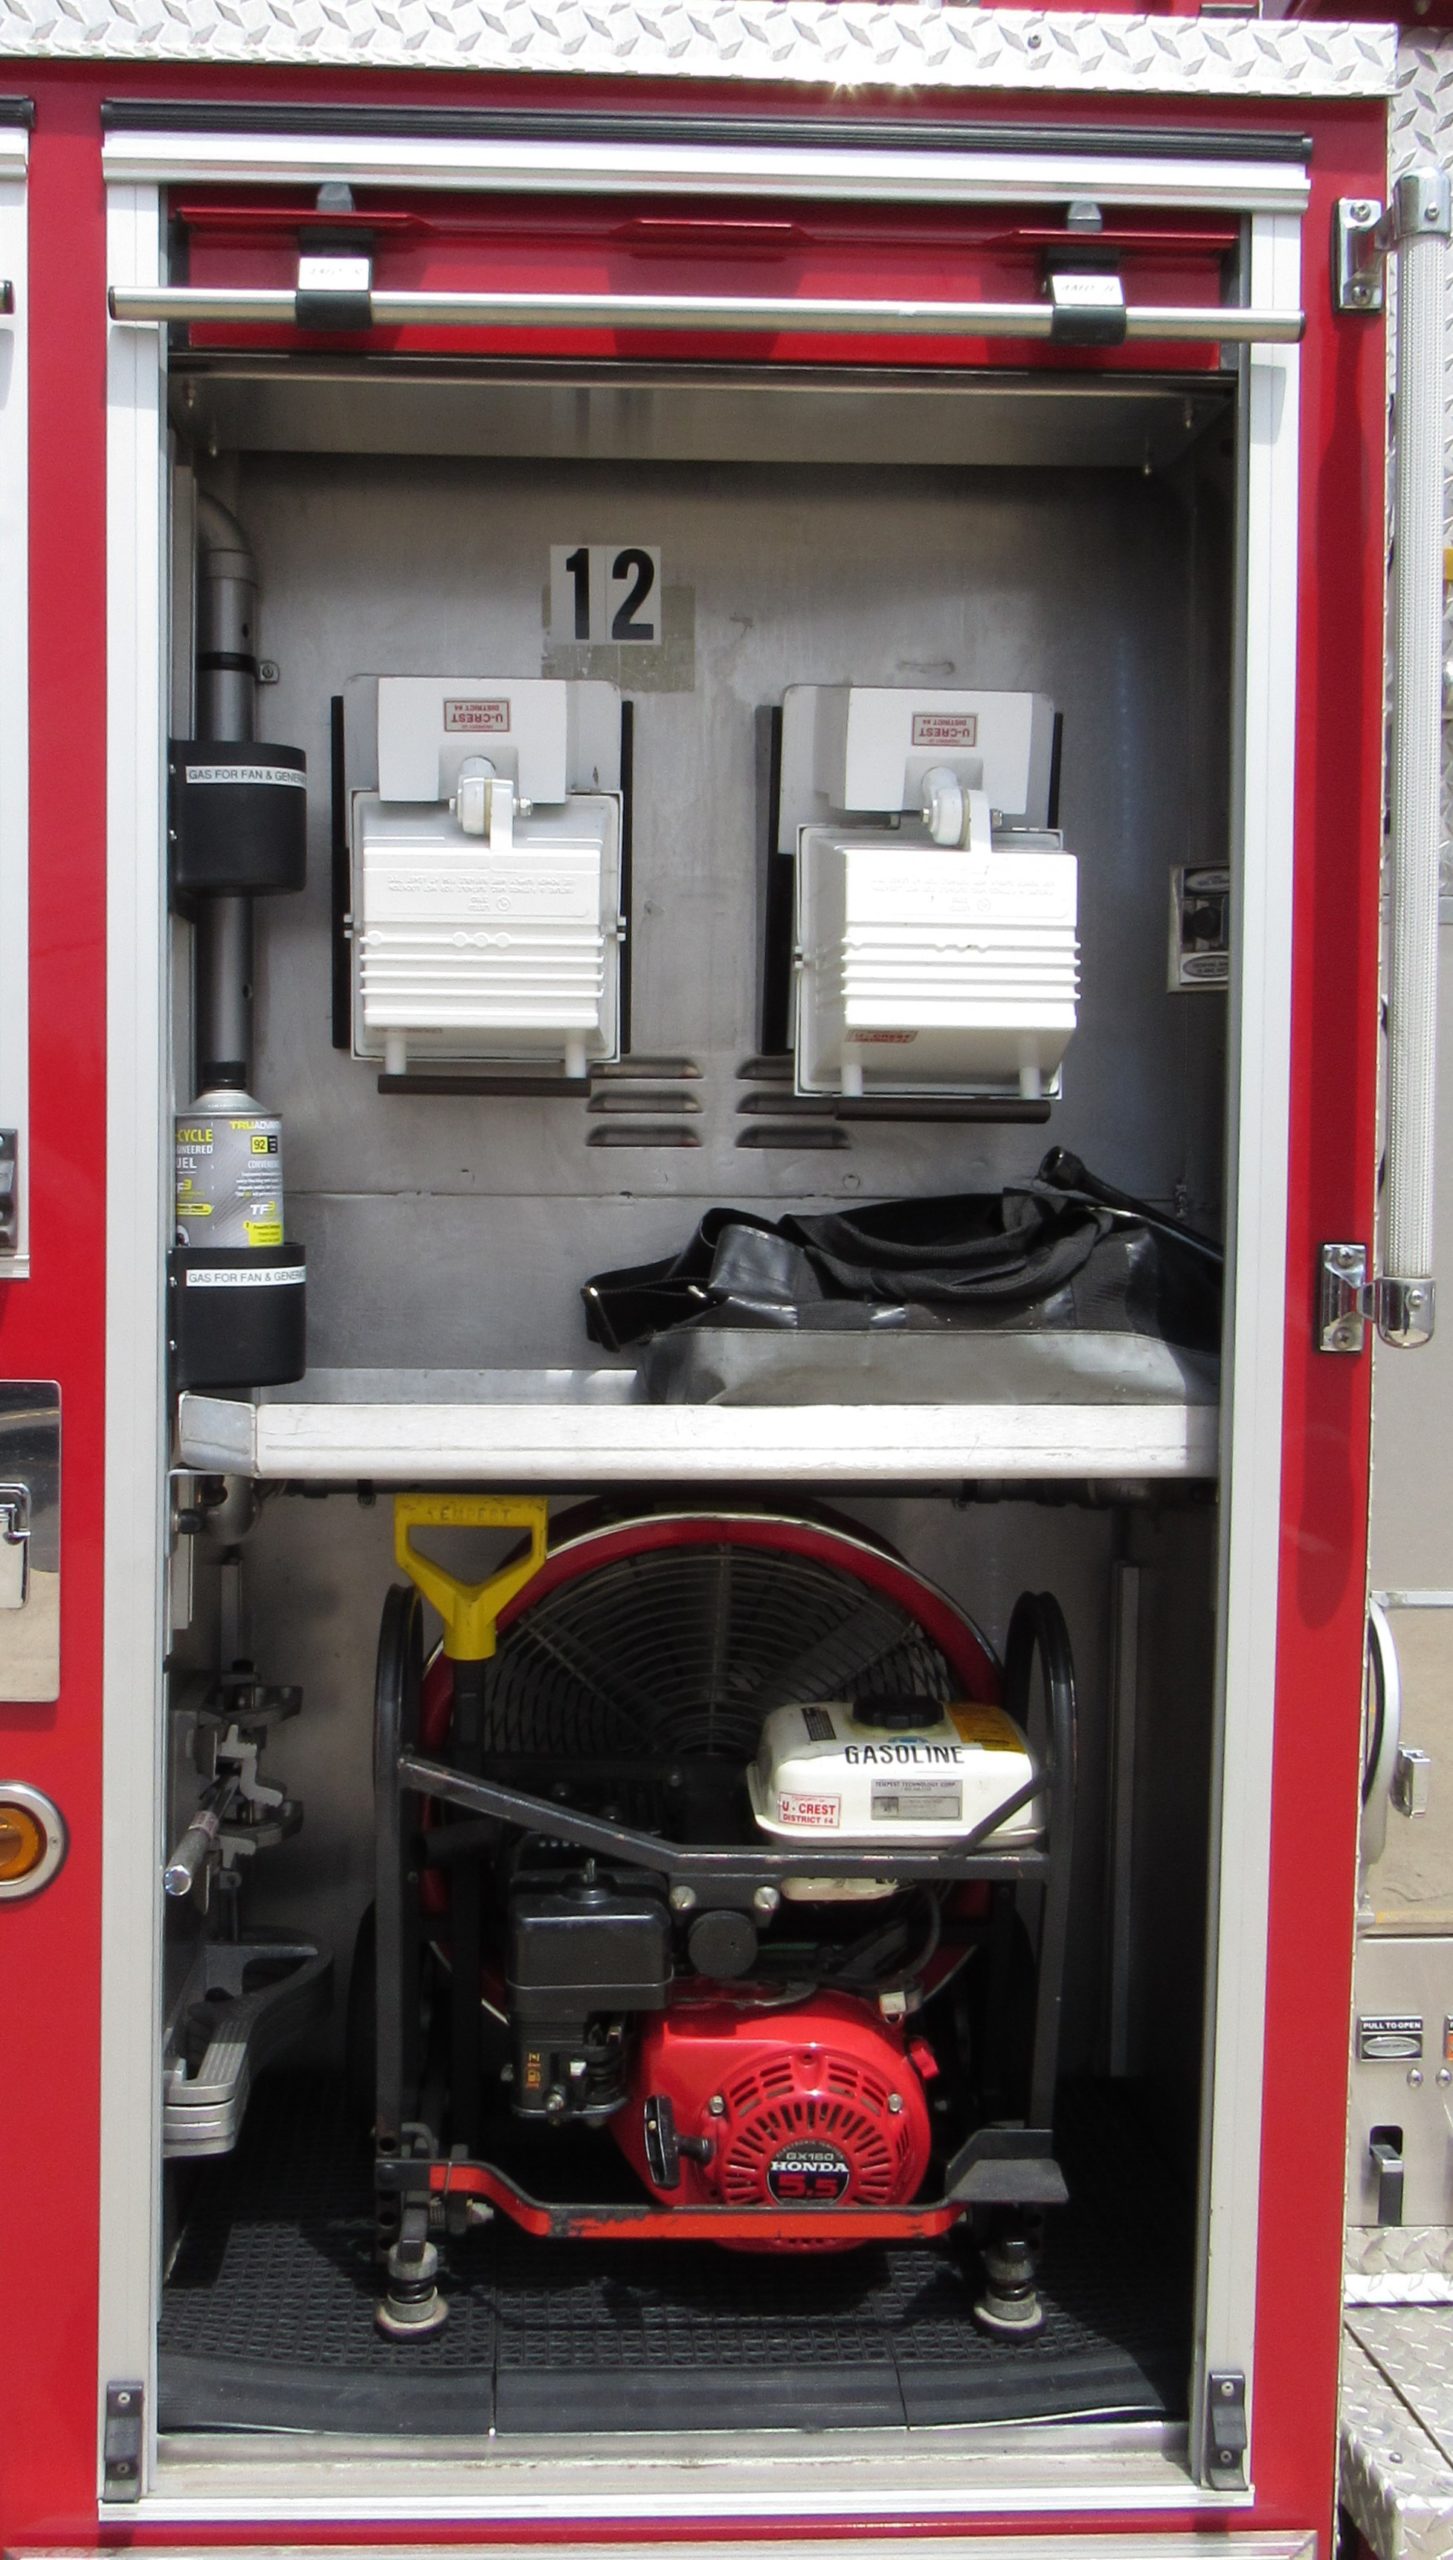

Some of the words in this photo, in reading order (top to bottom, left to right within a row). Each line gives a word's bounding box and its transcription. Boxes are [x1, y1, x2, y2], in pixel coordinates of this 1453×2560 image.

[566, 548, 655, 640] 12
[451, 713, 503, 723] U-CREST
[919, 728, 970, 738] U-CREST
[188, 769, 212, 780] GAS
[215, 769, 238, 780] FOR
[241, 769, 263, 780] FAN
[265, 770, 273, 780] &
[253, 1139, 266, 1150] 92
[188, 1273, 212, 1283] GAS
[214, 1273, 238, 1283] FOR
[240, 1272, 262, 1283] FAN
[265, 1272, 272, 1282] &
[844, 1745, 965, 1764] GASOLINE
[783, 1814, 821, 1824] DISTRICT
[1363, 2022, 1384, 2030] PULL
[1399, 2021, 1421, 2029] OPEN
[786, 2152, 834, 2160] GX160
[770, 2161, 849, 2172] HONDA
[778, 2173, 838, 2197] 5.5
